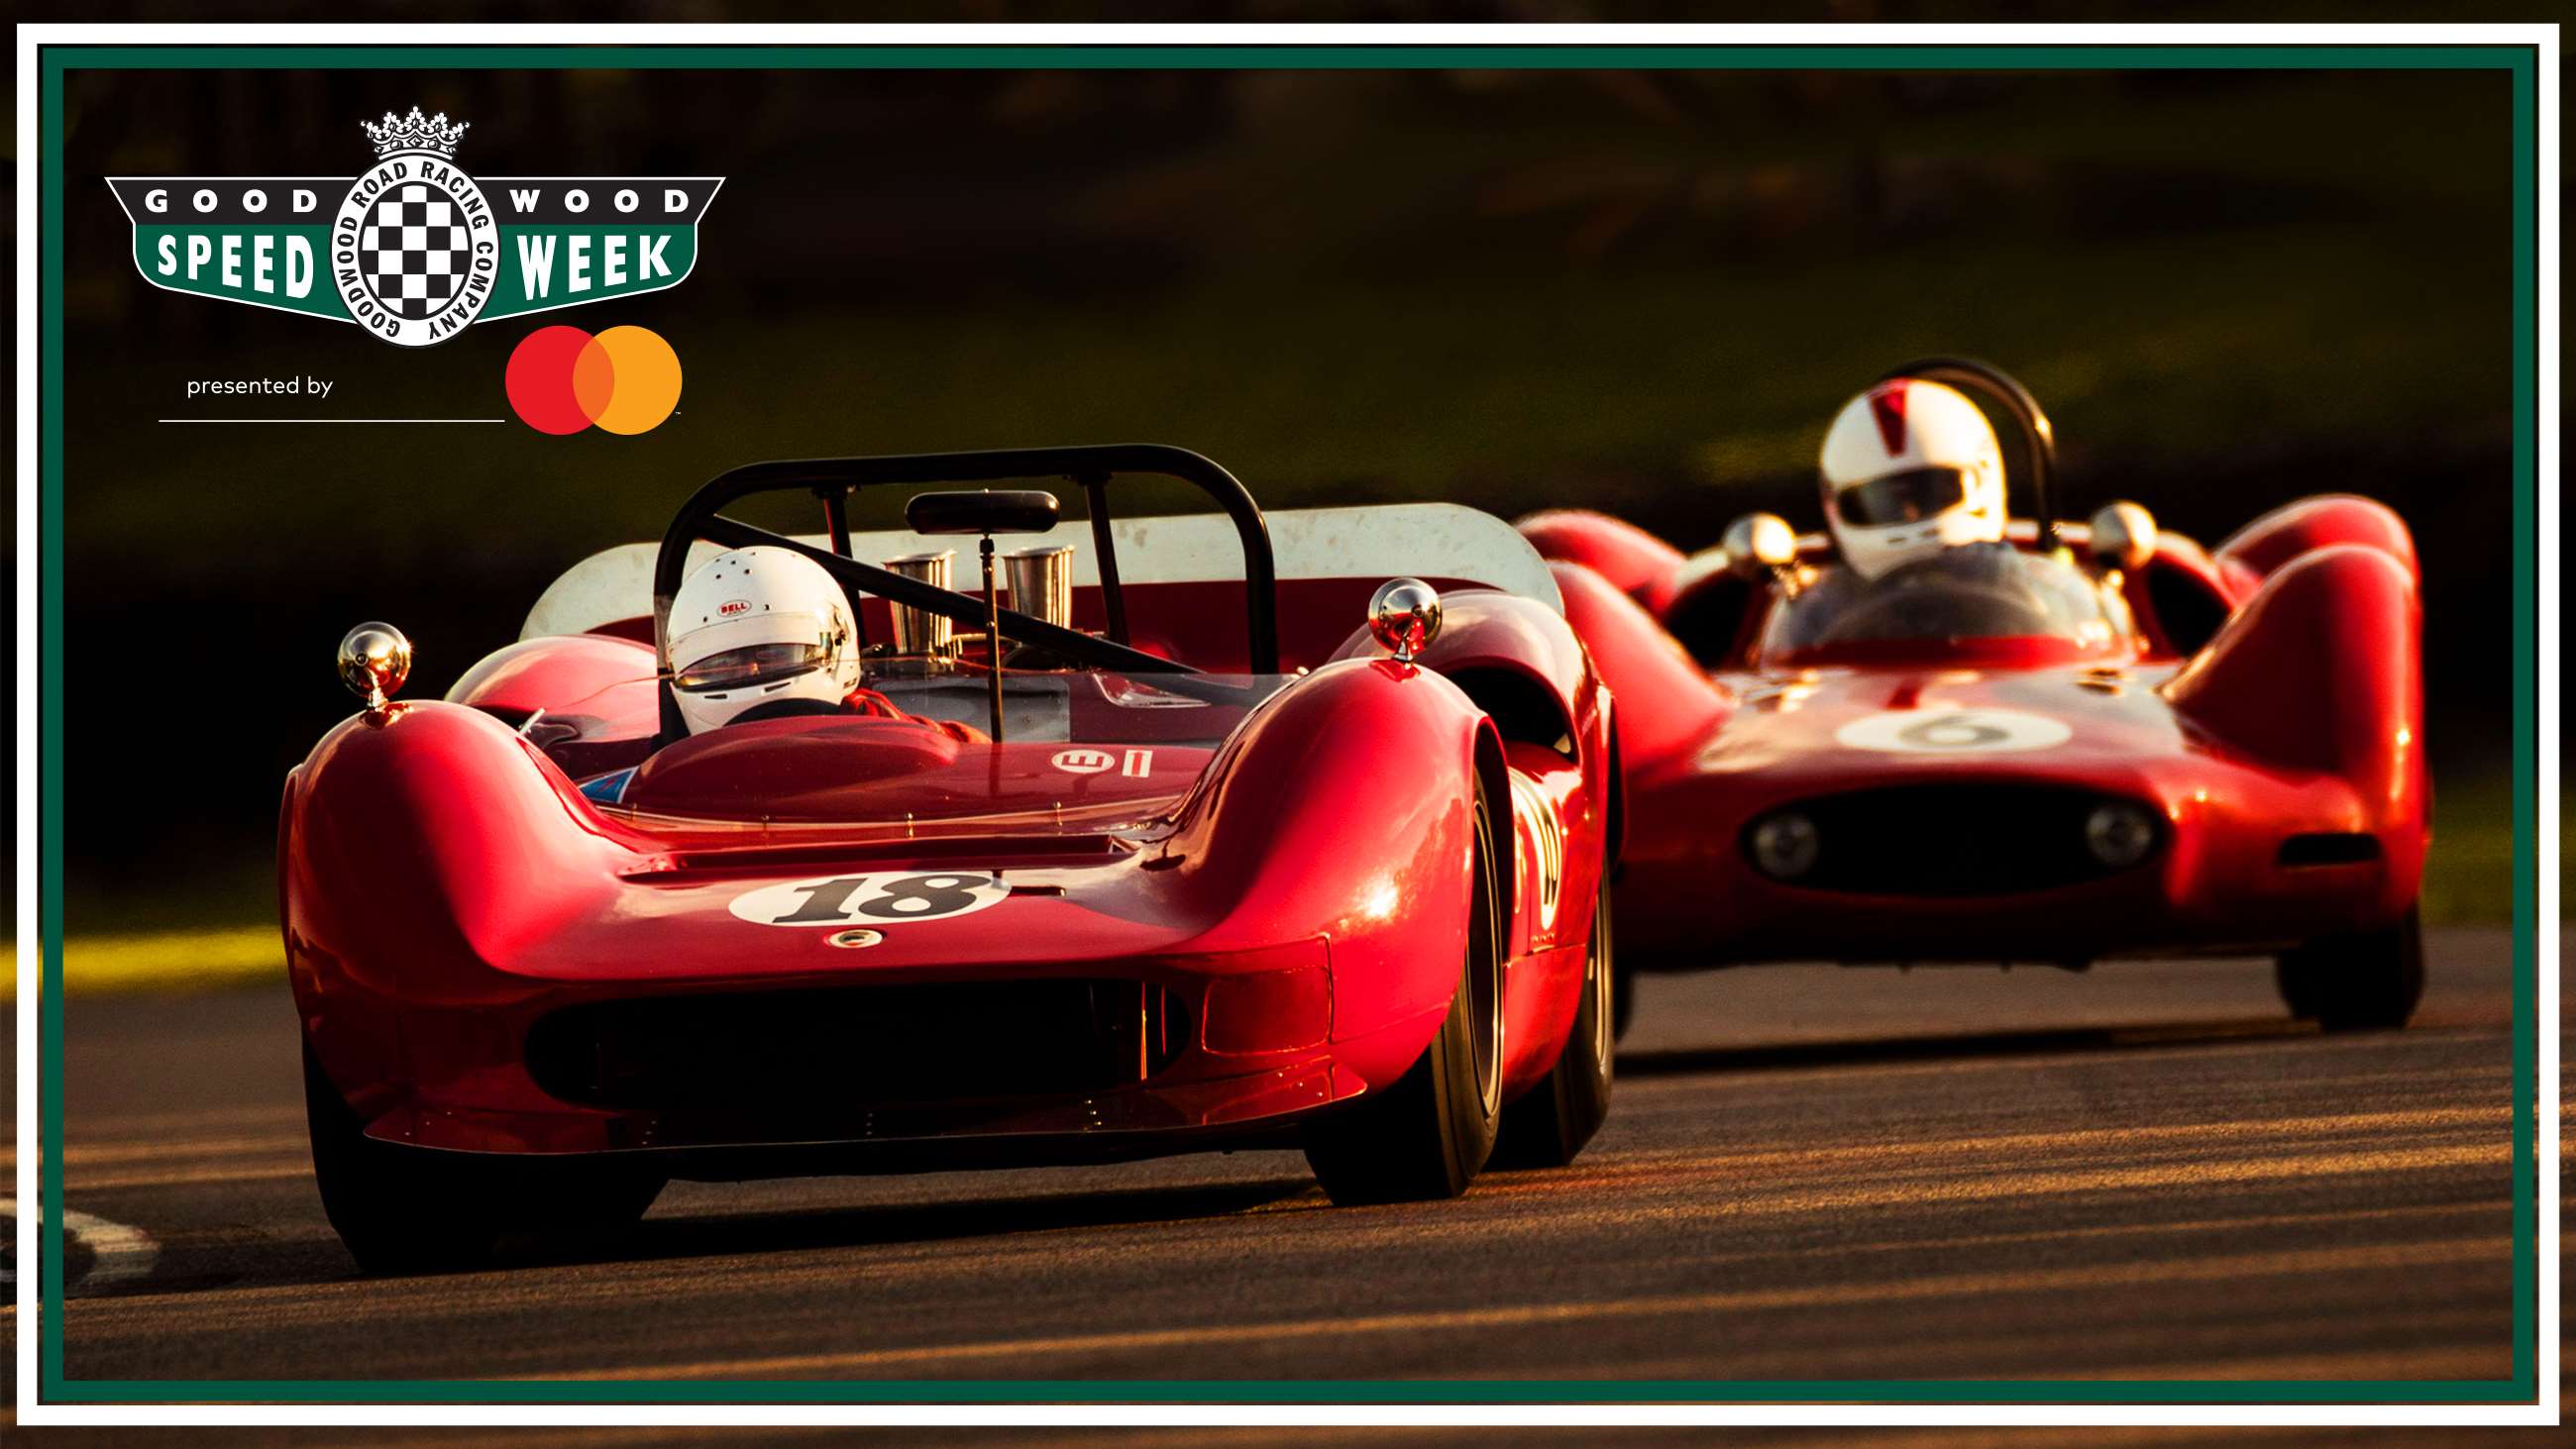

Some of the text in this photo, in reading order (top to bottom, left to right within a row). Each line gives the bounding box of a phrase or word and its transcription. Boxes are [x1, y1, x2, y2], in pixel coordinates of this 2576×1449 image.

[721, 602, 746, 613] BELL
[1897, 714, 2012, 749] 6
[772, 875, 992, 923] 18
